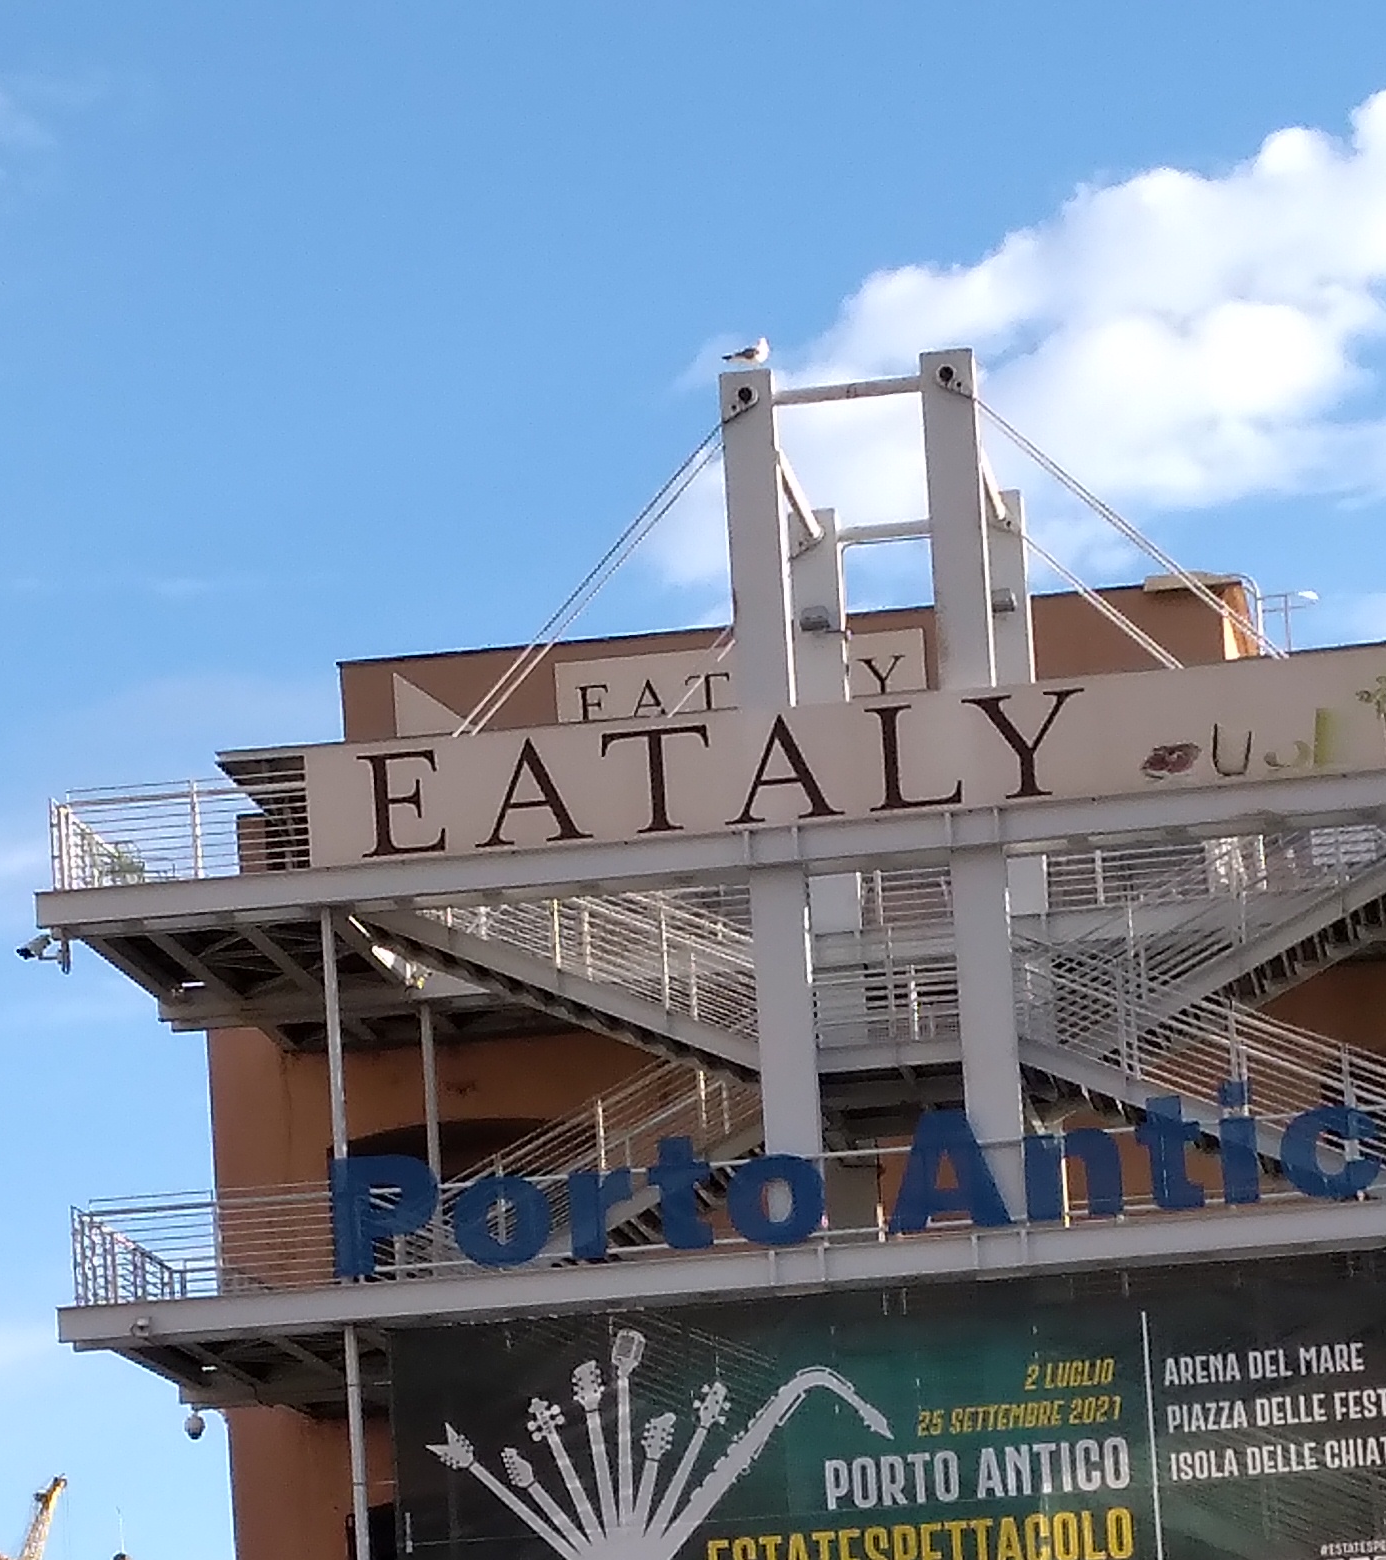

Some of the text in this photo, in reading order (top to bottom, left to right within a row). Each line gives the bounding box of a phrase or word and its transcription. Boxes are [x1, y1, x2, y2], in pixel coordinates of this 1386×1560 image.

[576, 654, 906, 720] EATY
[356, 687, 1084, 859] EATALY
[329, 1134, 824, 1281] Porto
[1024, 1359, 1114, 1389] 2 LUGLIO
[1164, 1342, 1366, 1387] ARENA DEL MARE
[918, 1397, 1122, 1437] 25 SETTEMBRE 2021
[1166, 1400, 1250, 1434] PIAZZA
[1256, 1394, 1327, 1428] DELLE
[825, 1436, 1131, 1511] PORTO ANTICO
[1170, 1448, 1239, 1482] ISOLA
[1245, 1442, 1318, 1476] DELLE
